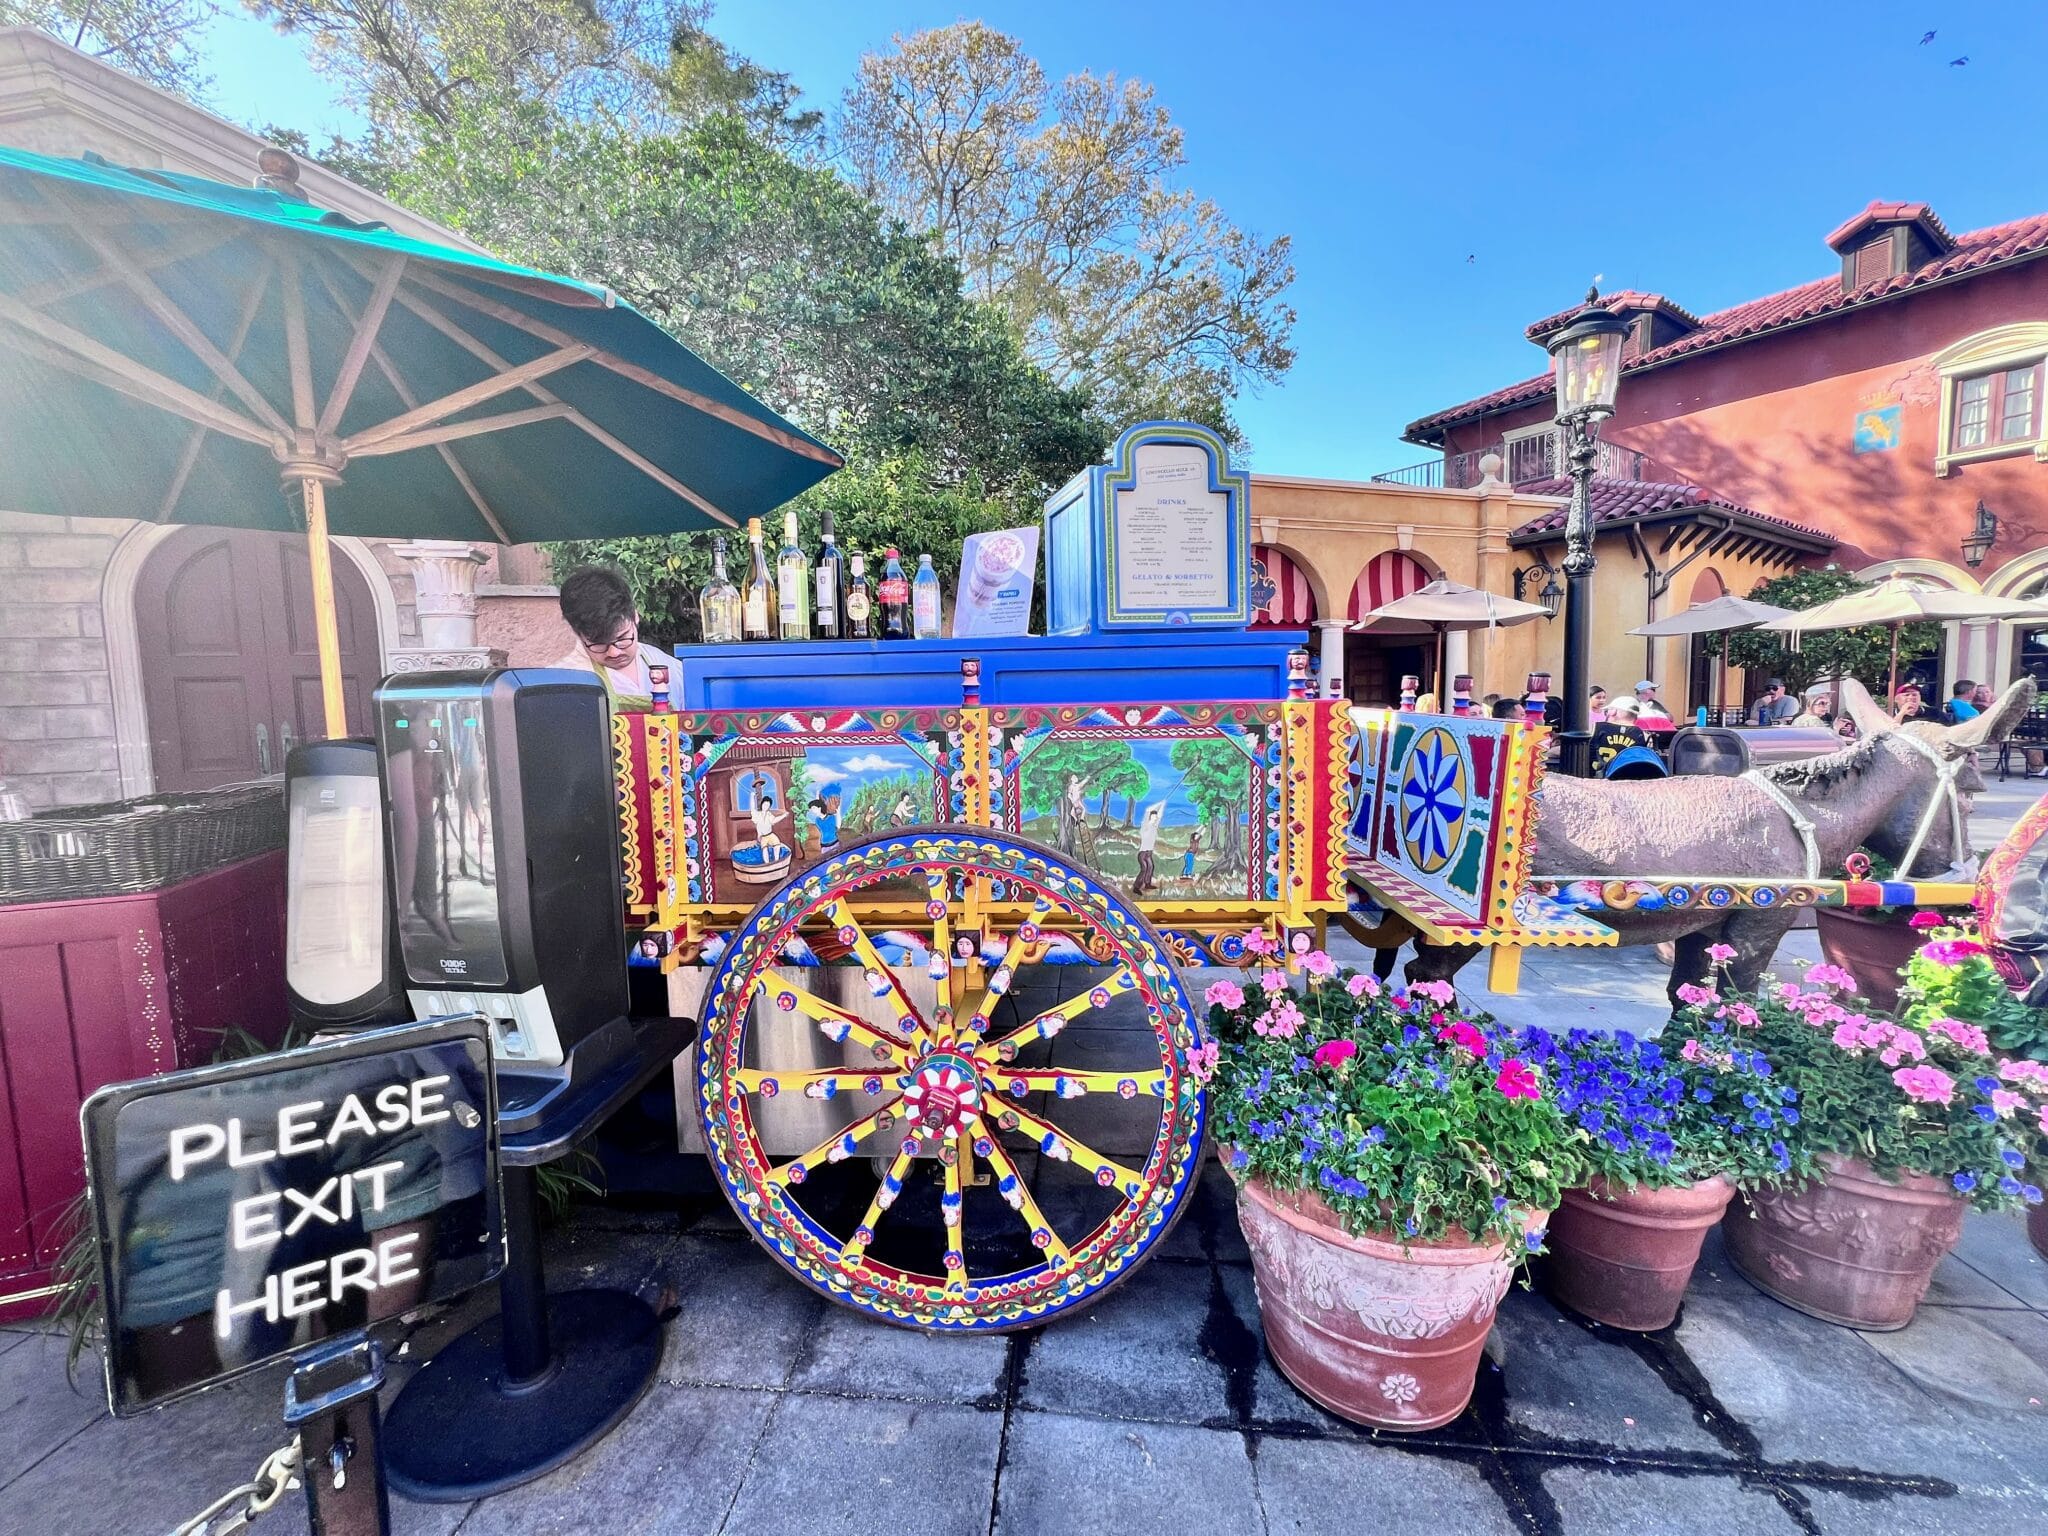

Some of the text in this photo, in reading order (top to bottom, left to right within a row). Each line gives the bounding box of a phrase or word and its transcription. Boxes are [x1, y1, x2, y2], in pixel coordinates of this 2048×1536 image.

[1606, 734, 1636, 748] CURRY
[168, 1074, 451, 1181] PLEASE
[232, 1160, 405, 1251] EXIT
[215, 1231, 421, 1339] HERE
